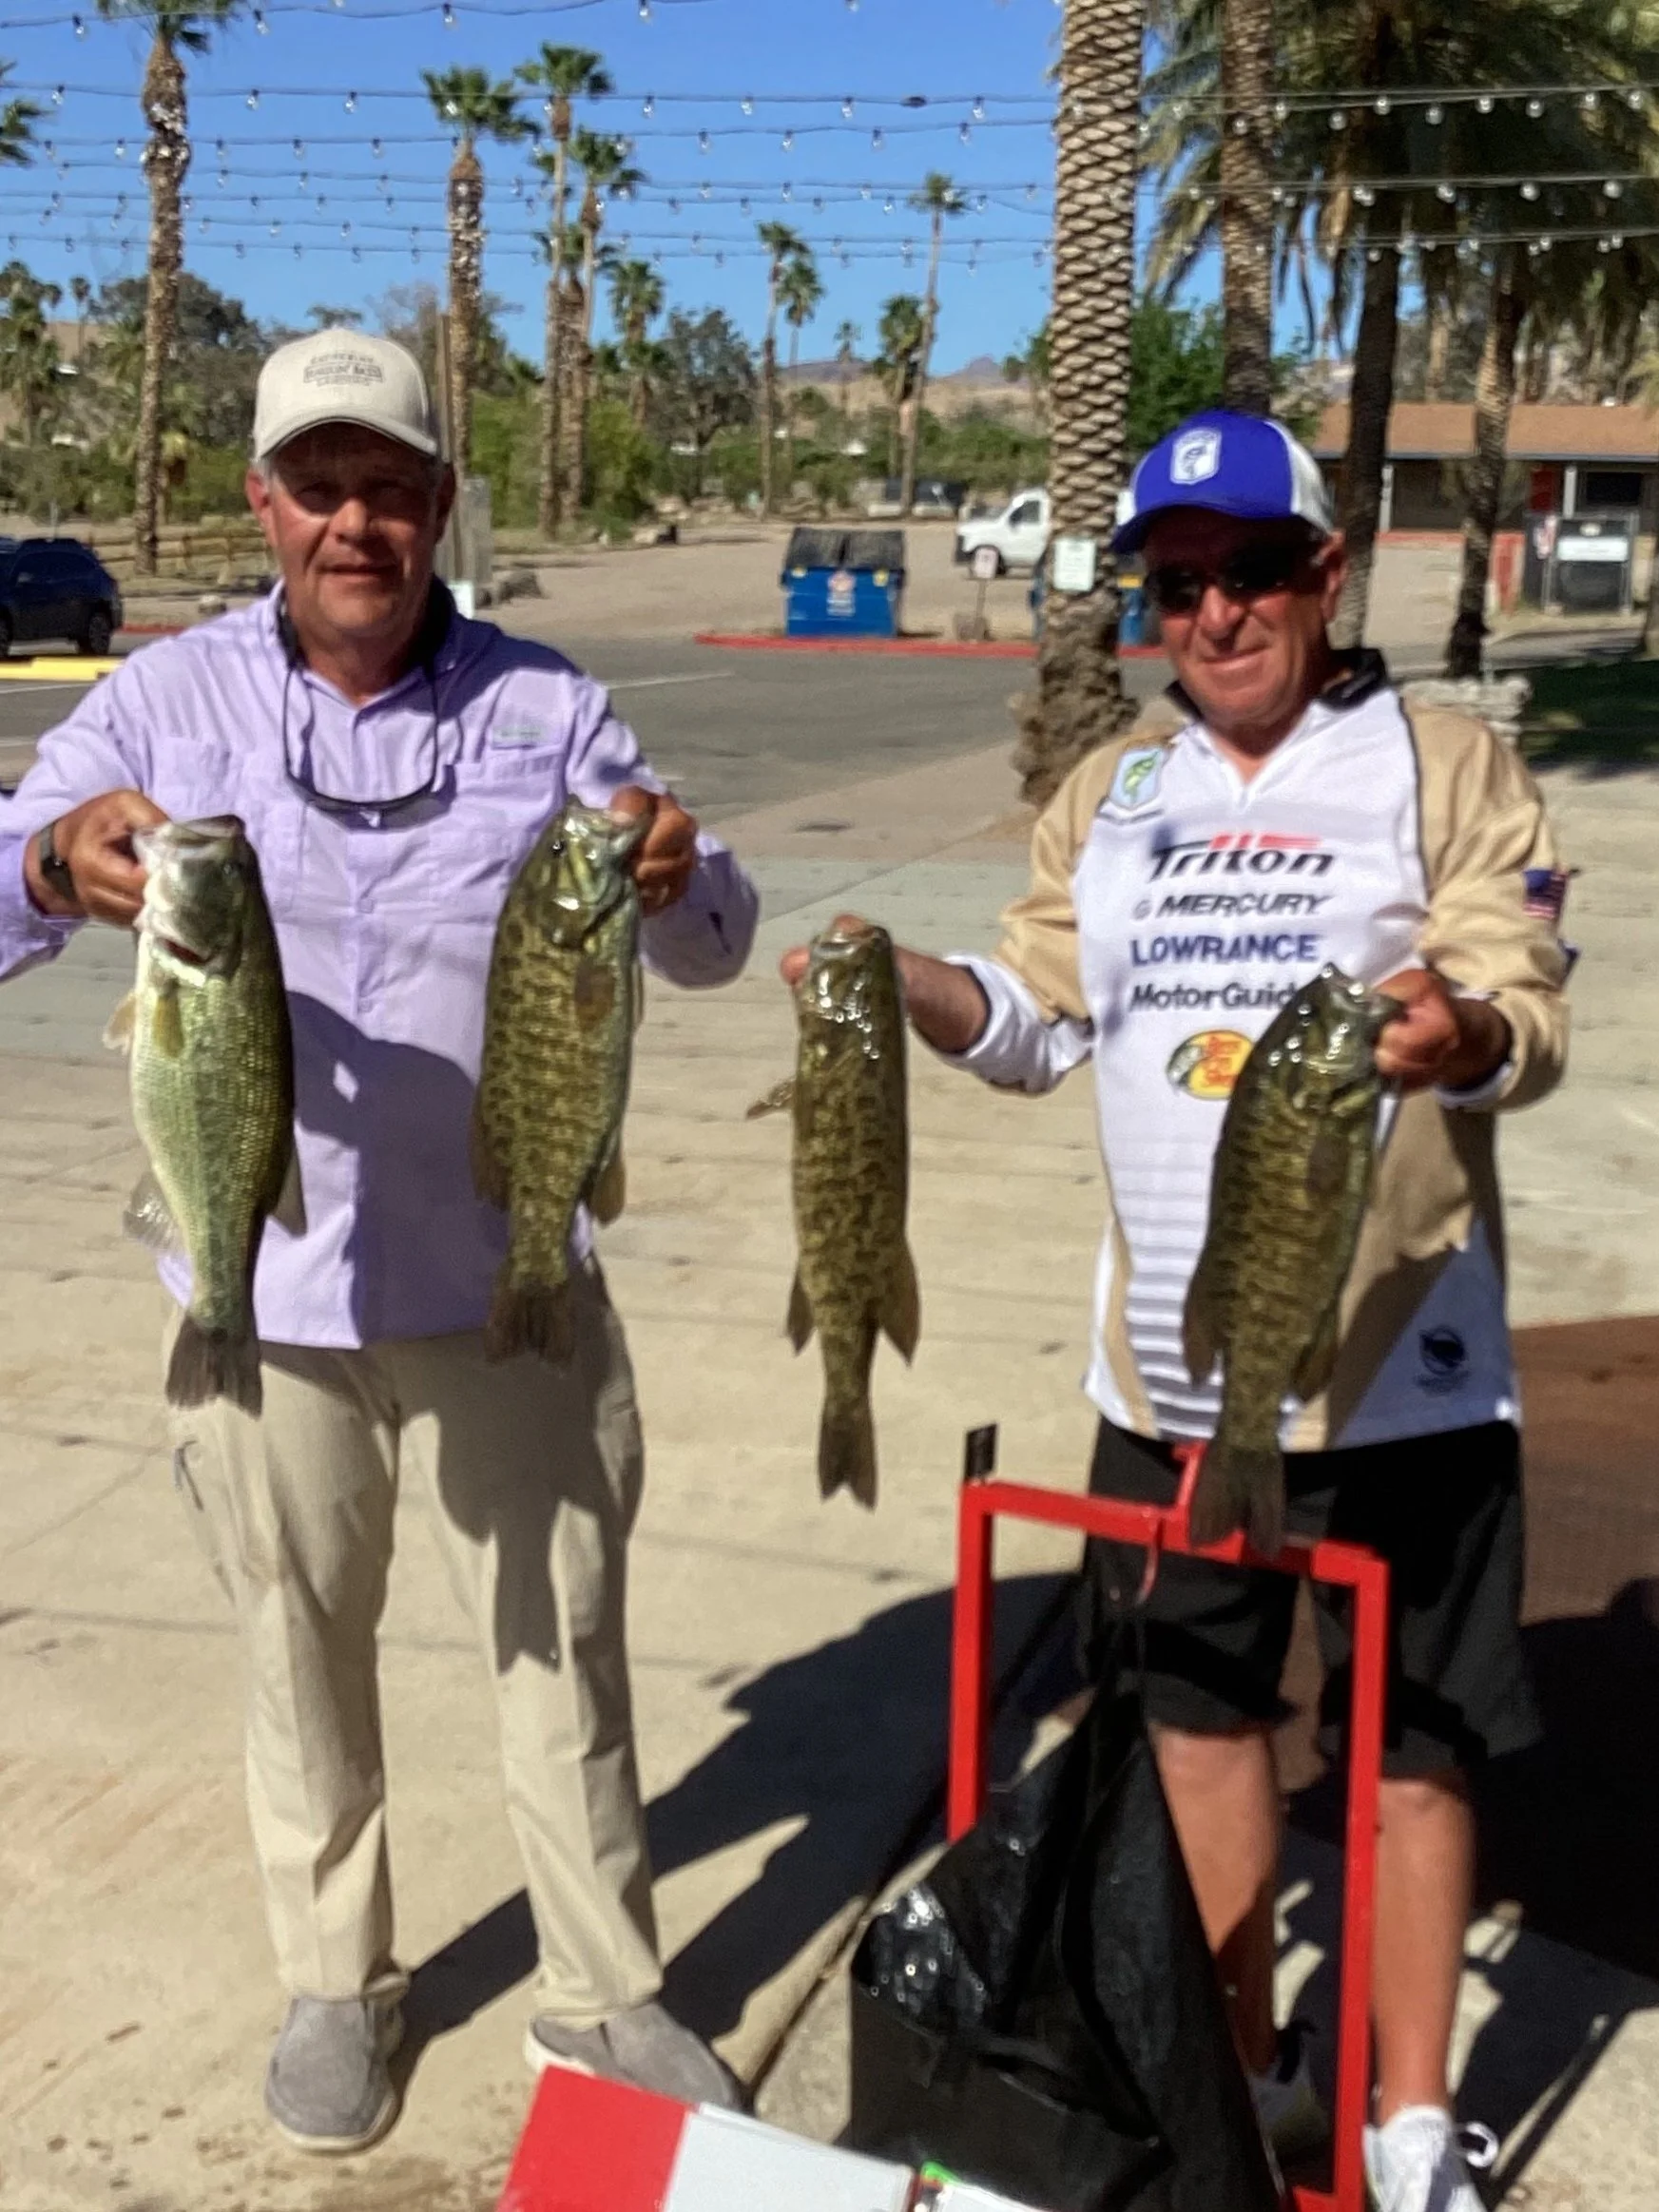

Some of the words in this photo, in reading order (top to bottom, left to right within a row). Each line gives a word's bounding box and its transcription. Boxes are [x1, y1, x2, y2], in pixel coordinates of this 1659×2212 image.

[1148, 840, 1334, 881] Triton
[1155, 894, 1332, 917] MERCURY
[1130, 934, 1320, 967] LOWRANCE
[1130, 982, 1300, 1010] MotorGuid
